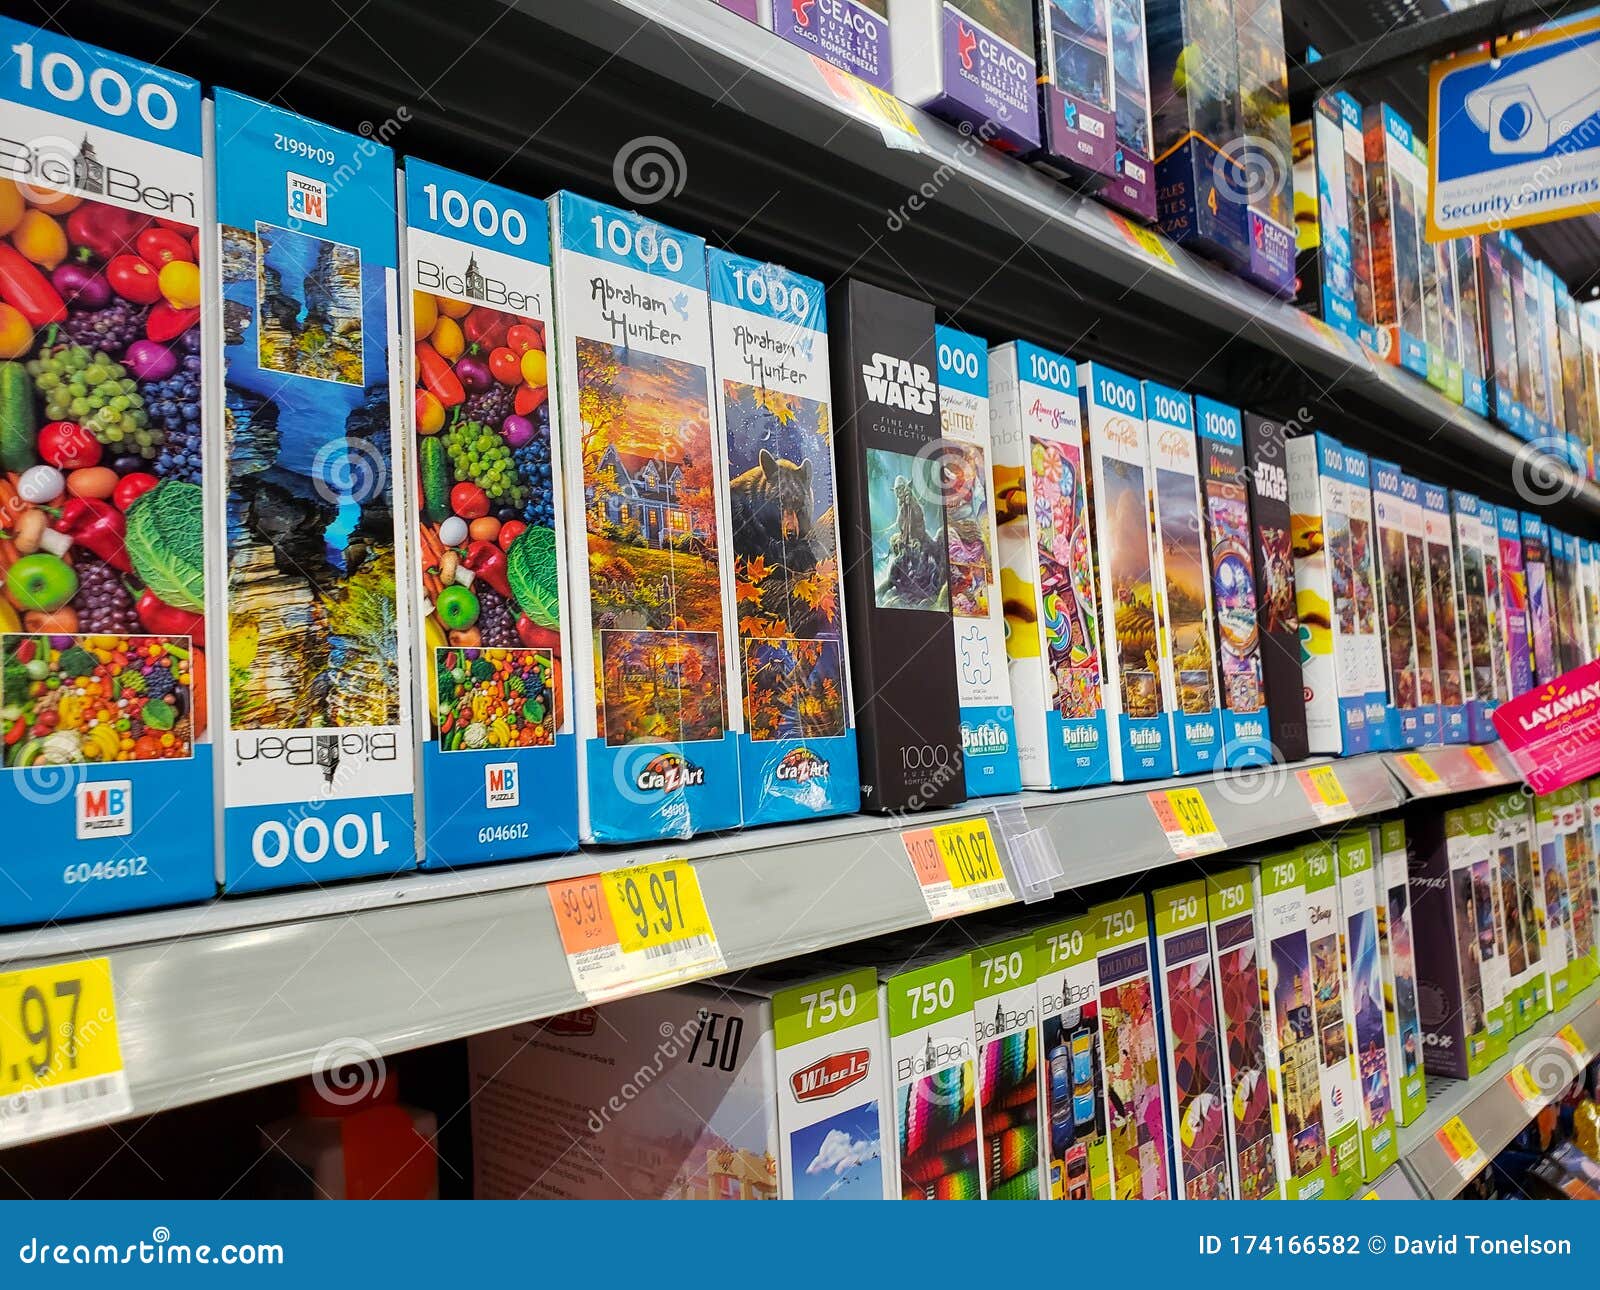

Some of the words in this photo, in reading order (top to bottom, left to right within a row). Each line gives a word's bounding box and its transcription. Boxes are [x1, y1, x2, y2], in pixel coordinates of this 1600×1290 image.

[819, 0, 877, 41] CEACO
[820, 15, 878, 55] PUZZLES
[793, 25, 818, 43] CEACO
[821, 39, 879, 76] ROMPECABEZAS
[979, 38, 1027, 81] CEACO
[11, 42, 179, 130] 1000
[1390, 117, 1409, 146] 1000
[273, 132, 336, 166] 6046612
[106, 168, 195, 218] Ben
[292, 179, 322, 195] PUZZLE
[1207, 186, 1218, 216] 4
[1441, 193, 1514, 222] Security
[1518, 177, 1599, 206] cameras
[292, 190, 322, 218] MB
[423, 182, 527, 246] 1000
[591, 215, 683, 272] 1000
[417, 259, 464, 296] Big
[484, 276, 541, 316] Ben
[590, 276, 667, 316] Abraham
[732, 269, 809, 319] 1000
[602, 310, 681, 352] Hunter
[733, 324, 796, 358] Abraham
[744, 354, 807, 400] Hunter
[862, 351, 936, 392] STAR
[938, 344, 979, 379] 000
[1030, 353, 1071, 389] 1000
[863, 374, 937, 416] WARS
[1099, 379, 1136, 412] 1000
[1154, 395, 1187, 424] 1000
[872, 423, 935, 443] COLLECTION
[908, 422, 925, 433] ART
[1204, 411, 1236, 439] 1000
[1253, 461, 1287, 483] STAR
[1324, 447, 1343, 471] 1000
[1345, 455, 1366, 478] 1000
[1255, 477, 1288, 502] WARS
[1377, 470, 1398, 492] 1000
[1425, 490, 1444, 510] 1000
[1518, 680, 1600, 731] LAYAWAY
[960, 723, 1008, 748] Buffalo
[1062, 725, 1099, 746] Buffalo
[1130, 727, 1162, 745] Buffalo
[1184, 721, 1215, 740] Buffalo
[1234, 721, 1263, 738] Buffalo
[236, 735, 314, 766] Ben
[341, 732, 397, 762] Big
[899, 743, 950, 770] 1000
[489, 768, 515, 792] MB
[84, 788, 127, 818] MB
[490, 791, 515, 801] PUZZLE
[84, 817, 125, 830] PUZZLE
[478, 822, 529, 844] 6046612
[251, 811, 390, 868] 1000
[63, 855, 148, 885] 6046612
[943, 831, 995, 883] $10.97
[1307, 855, 1328, 878] 750
[1346, 848, 1365, 871] 750
[1272, 862, 1296, 888] 750
[560, 883, 603, 926] $9.97
[616, 869, 685, 938] $9.97
[1168, 895, 1198, 923] 750
[1219, 884, 1245, 911] 750
[1102, 909, 1135, 940] 750
[1047, 929, 1083, 964] 750
[980, 951, 1023, 988] 750
[801, 983, 857, 1029] 750
[906, 977, 955, 1020] 750
[1043, 993, 1063, 1015] Big
[1072, 983, 1095, 1004] Ben
[0, 978, 82, 1081] .97
[1005, 1008, 1035, 1030] Ben
[688, 1008, 744, 1073] 750
[800, 1055, 870, 1093] Wheels
[897, 1050, 926, 1081] Big
[936, 1040, 969, 1065] Ben
